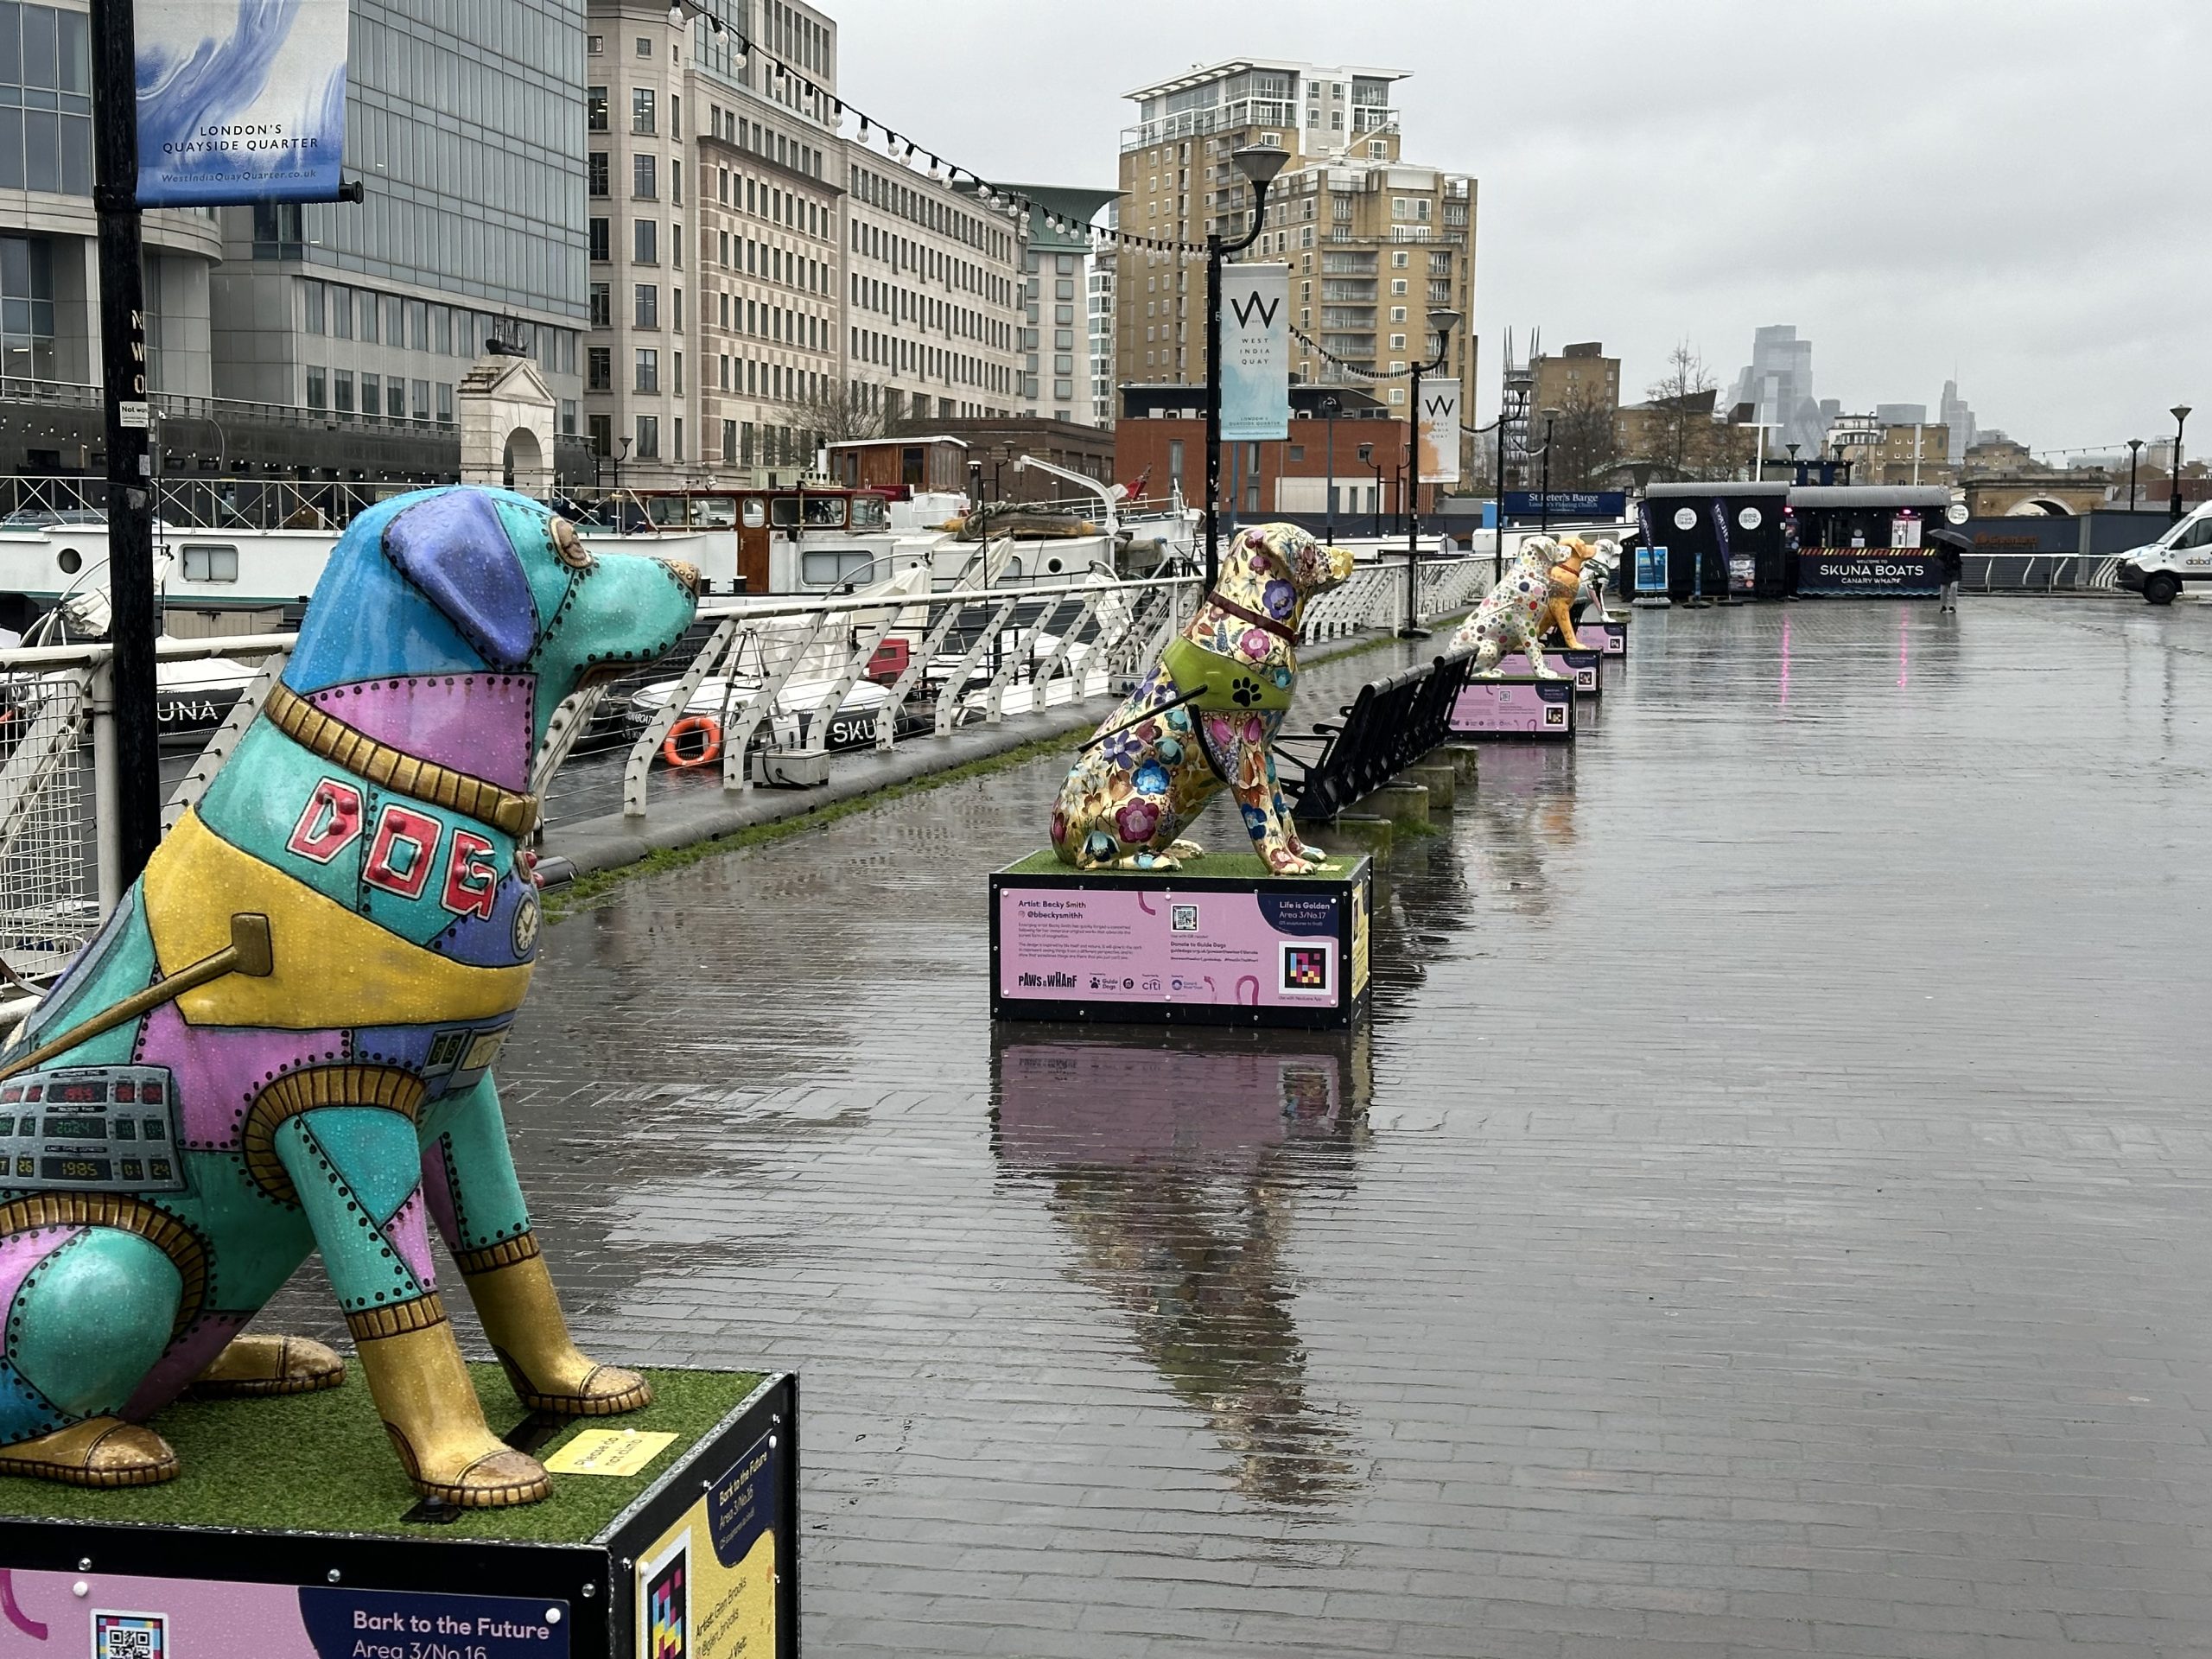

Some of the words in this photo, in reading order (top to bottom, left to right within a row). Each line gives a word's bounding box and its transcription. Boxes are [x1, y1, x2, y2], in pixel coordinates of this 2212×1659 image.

[200, 124, 283, 137] LONDON'S
[162, 140, 239, 155] QUAYSIDE
[246, 138, 319, 151] QUARTER
[161, 169, 317, 183] WestIndiaQuayQuarter.co.uk
[1529, 493, 1538, 502] St
[1573, 493, 1599, 504] Barge
[1820, 565, 1872, 575] SKUNA
[1875, 565, 1924, 575] BOATS
[833, 719, 899, 743] SKUA
[285, 776, 499, 922] DOG
[1019, 972, 1042, 987] PAWS
[1047, 971, 1077, 988] WHARF
[1142, 979, 1160, 990] citi
[62, 1162, 98, 1176] 1985
[719, 1482, 734, 1506] Bark
[749, 1452, 767, 1476] Future
[719, 1509, 733, 1530] Area
[353, 1611, 405, 1631] Bark
[410, 1616, 432, 1632] to
[436, 1616, 472, 1635] the
[477, 1618, 550, 1639] Future
[353, 1640, 404, 1658] Area
